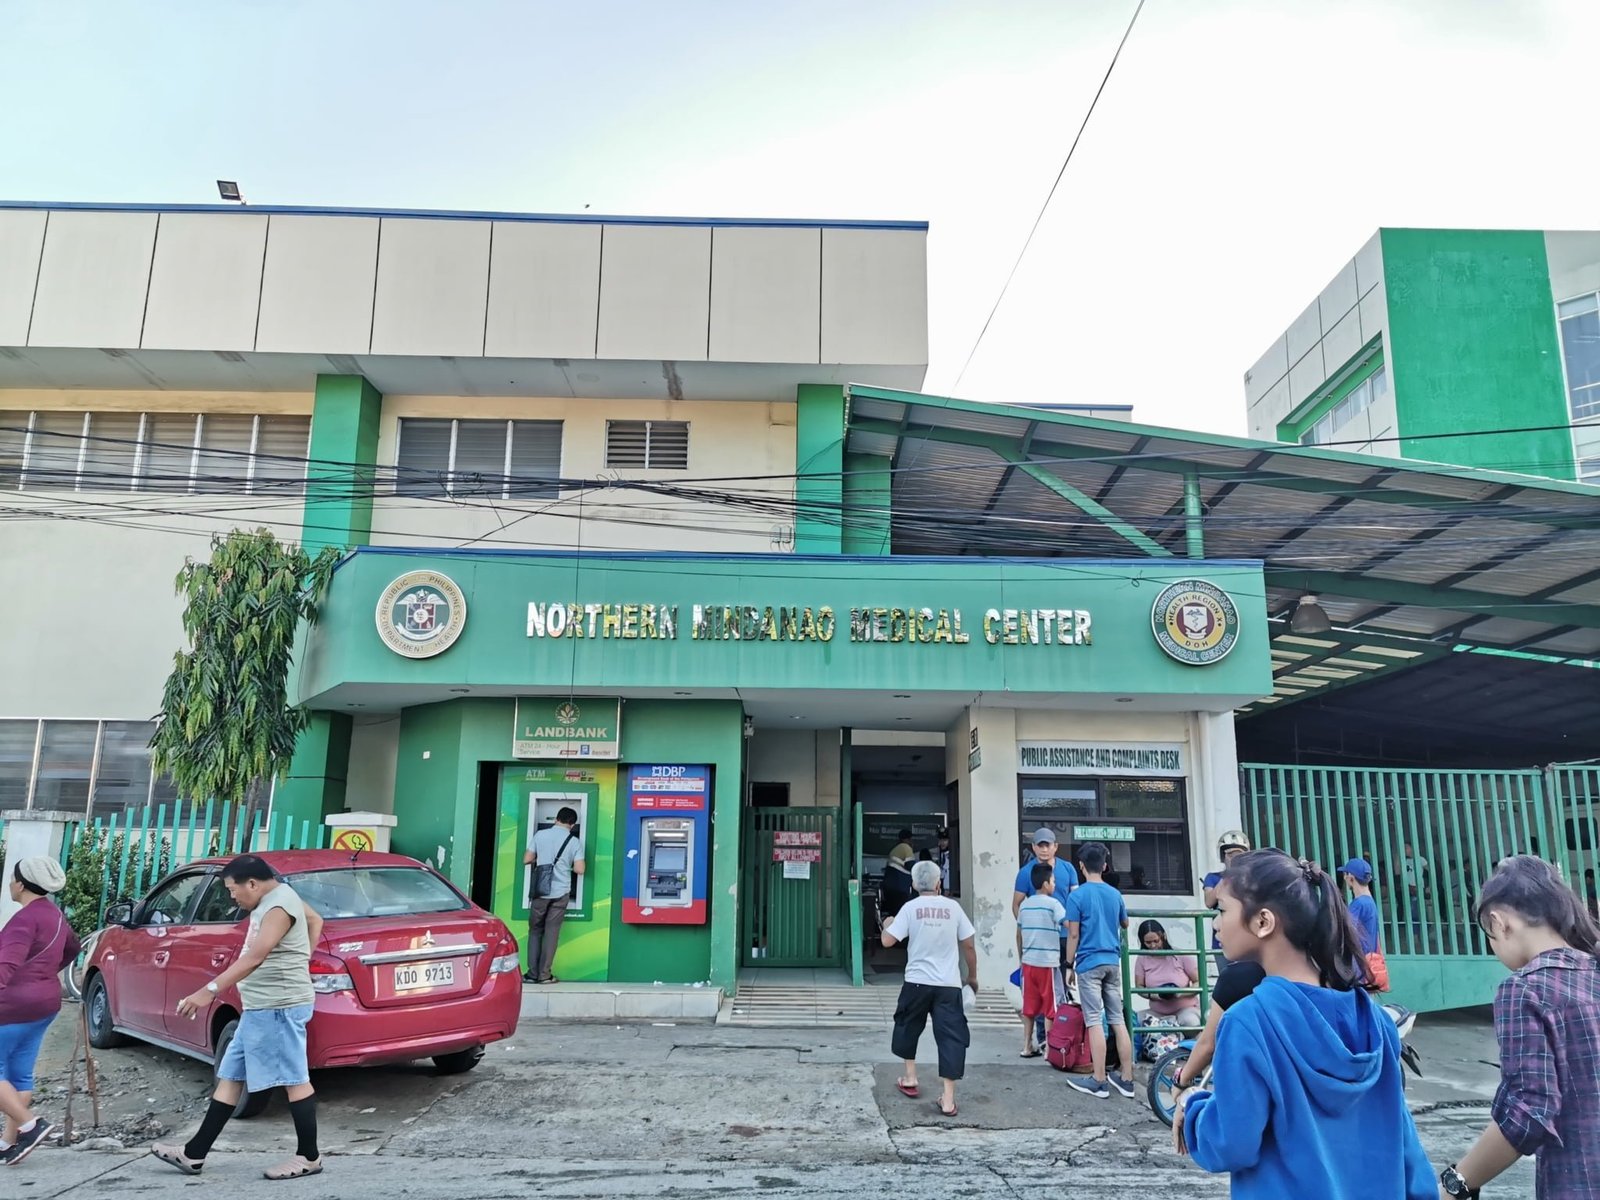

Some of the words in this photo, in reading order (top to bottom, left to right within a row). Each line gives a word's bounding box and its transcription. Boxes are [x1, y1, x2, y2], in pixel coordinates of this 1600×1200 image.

[381, 579, 409, 616] REPUBLIC
[428, 575, 462, 616] PHILIPPINES
[1168, 596, 1189, 622] HEALTH
[1191, 594, 1221, 615] REGION
[526, 602, 679, 640] NORTHERN
[692, 604, 836, 643] MINDANAO
[850, 606, 970, 644] MEDICAL
[984, 608, 1093, 646] CENTER
[380, 620, 425, 653] DEPARTMENT
[434, 621, 460, 647] HEALTH
[1159, 630, 1200, 662] MEDICAL
[1200, 632, 1235, 661] CENTER
[525, 726, 608, 738] LANDBANK
[1021, 747, 1048, 767] PUBLIC
[1049, 748, 1095, 768] ASSISTANCE
[1096, 749, 1111, 768] AND
[1112, 749, 1159, 769] COMPLAINTS
[1160, 750, 1180, 770] DESK
[526, 769, 546, 778] ATM
[663, 766, 686, 777] DBP
[916, 907, 951, 920] BATAS
[396, 971, 418, 986] KDO
[425, 967, 452, 983] 9713
